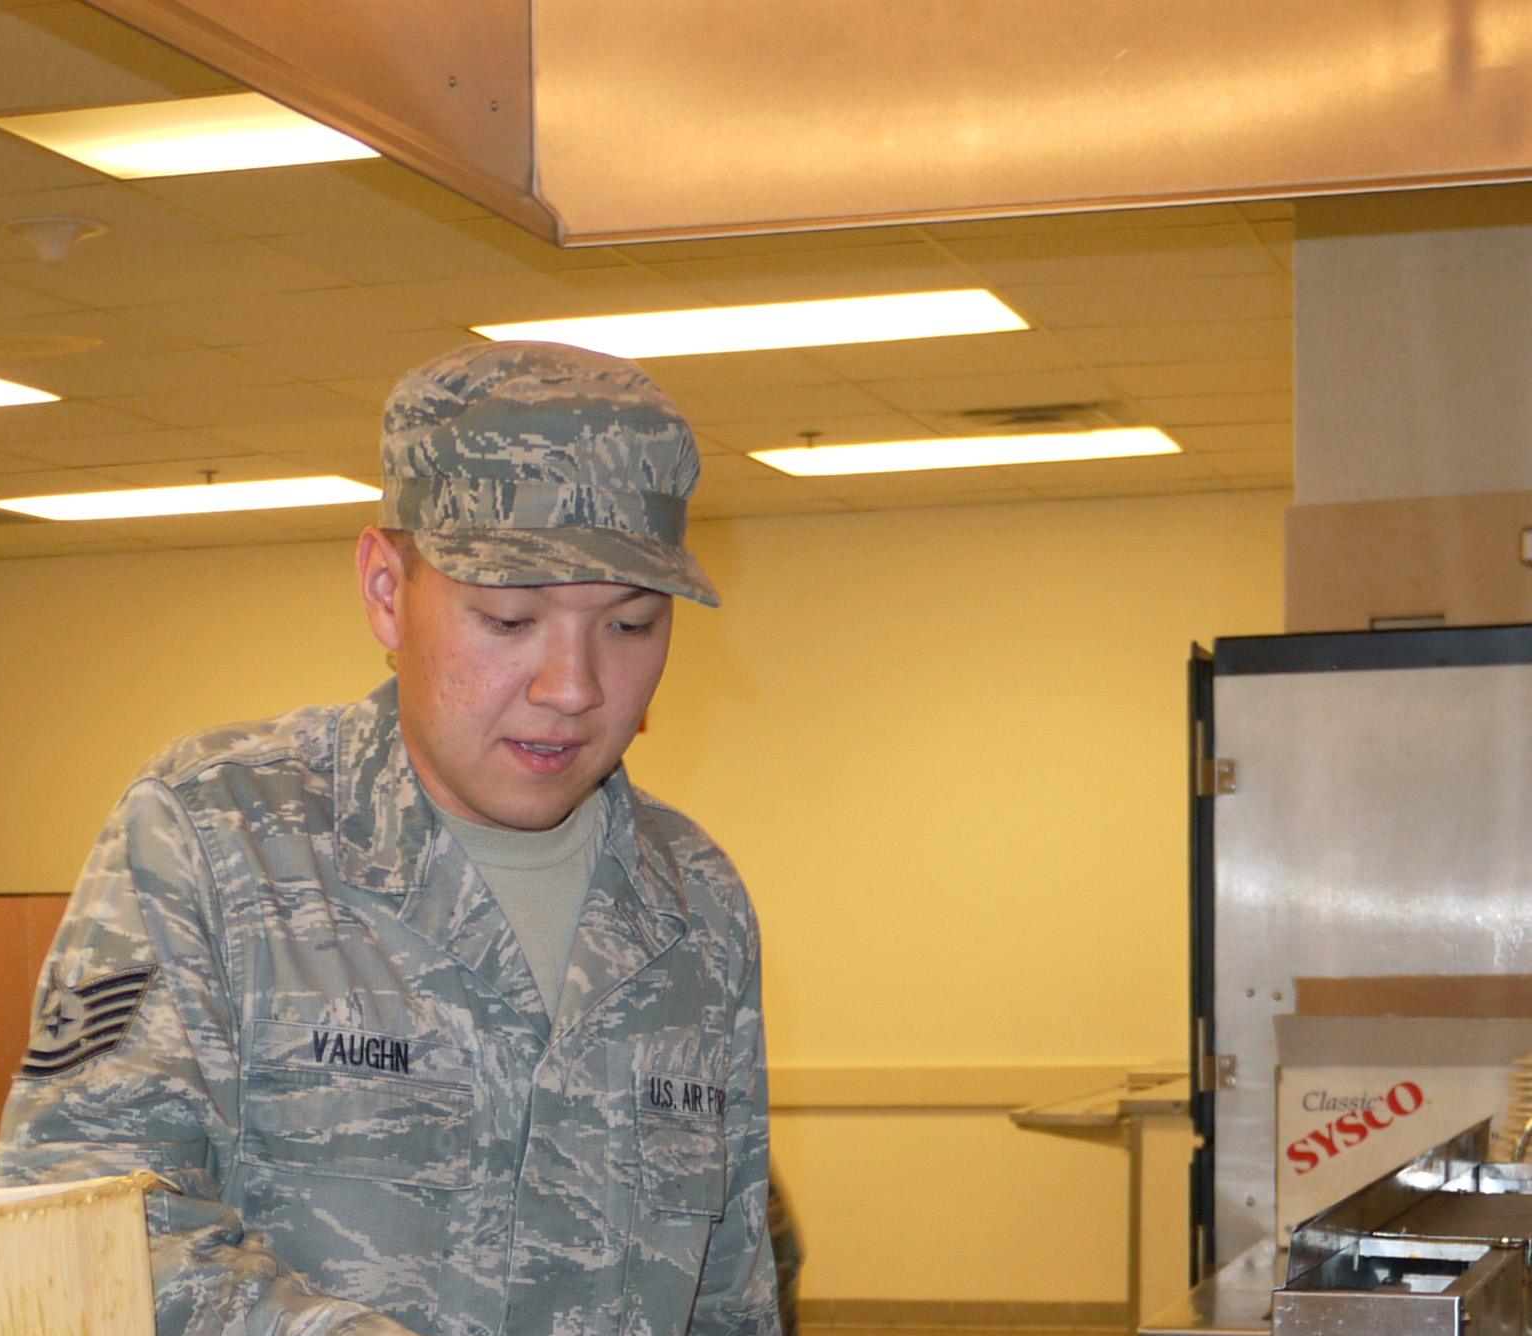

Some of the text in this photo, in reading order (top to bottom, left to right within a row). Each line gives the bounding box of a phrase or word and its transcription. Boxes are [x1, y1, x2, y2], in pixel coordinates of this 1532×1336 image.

[312, 1030, 409, 1074] VAUGHN
[650, 1077, 677, 1110] U.S.
[682, 1082, 704, 1113] AIR
[1302, 1091, 1377, 1112] Classic
[1286, 1081, 1424, 1175] SYSCO
